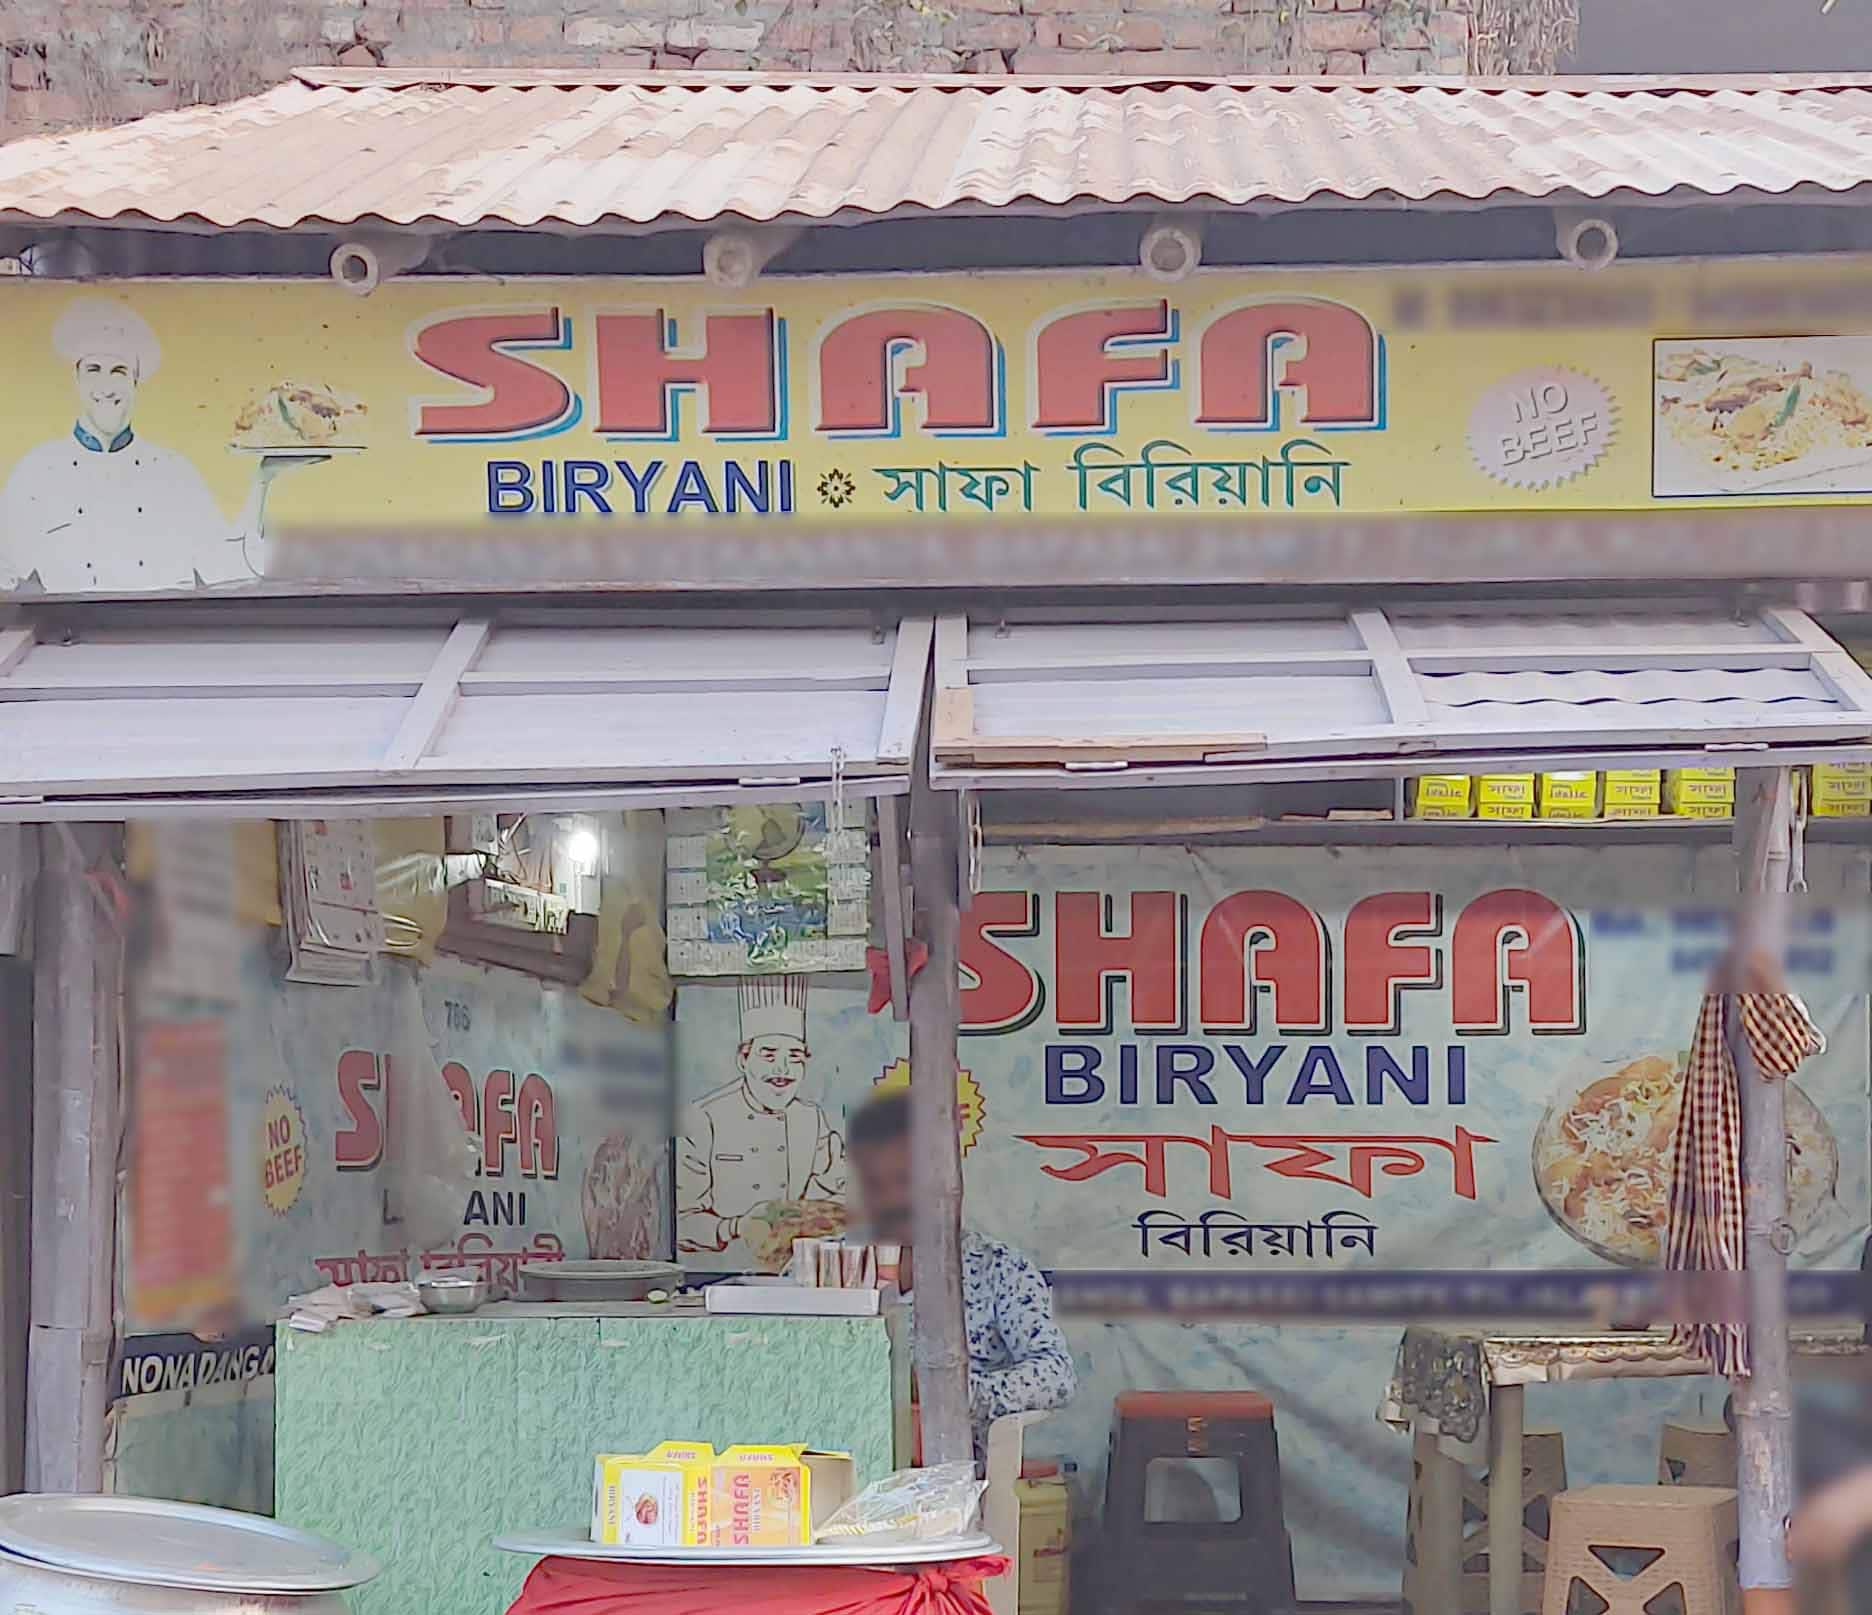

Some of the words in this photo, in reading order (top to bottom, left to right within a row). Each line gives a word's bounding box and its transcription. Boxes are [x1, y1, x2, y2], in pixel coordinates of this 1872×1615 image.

[413, 300, 1387, 444] SHAFA
[1511, 383, 1569, 424] NO
[1500, 410, 1598, 467] BEEF
[487, 460, 797, 514] BIRYANI
[873, 461, 1041, 512] সাফা
[1066, 440, 1352, 512] বিরিয়ানি
[959, 888, 1588, 1037] SHAFA
[1044, 1044, 1467, 1106] BIRYANI
[266, 1115, 291, 1151] NO
[1009, 1123, 1500, 1200] সাফা
[264, 1144, 303, 1189] BEEF
[1131, 1209, 1379, 1258] বিরিয়ানি
[121, 1344, 275, 1396] NONADANGA
[734, 1472, 750, 1546] SHAFA
